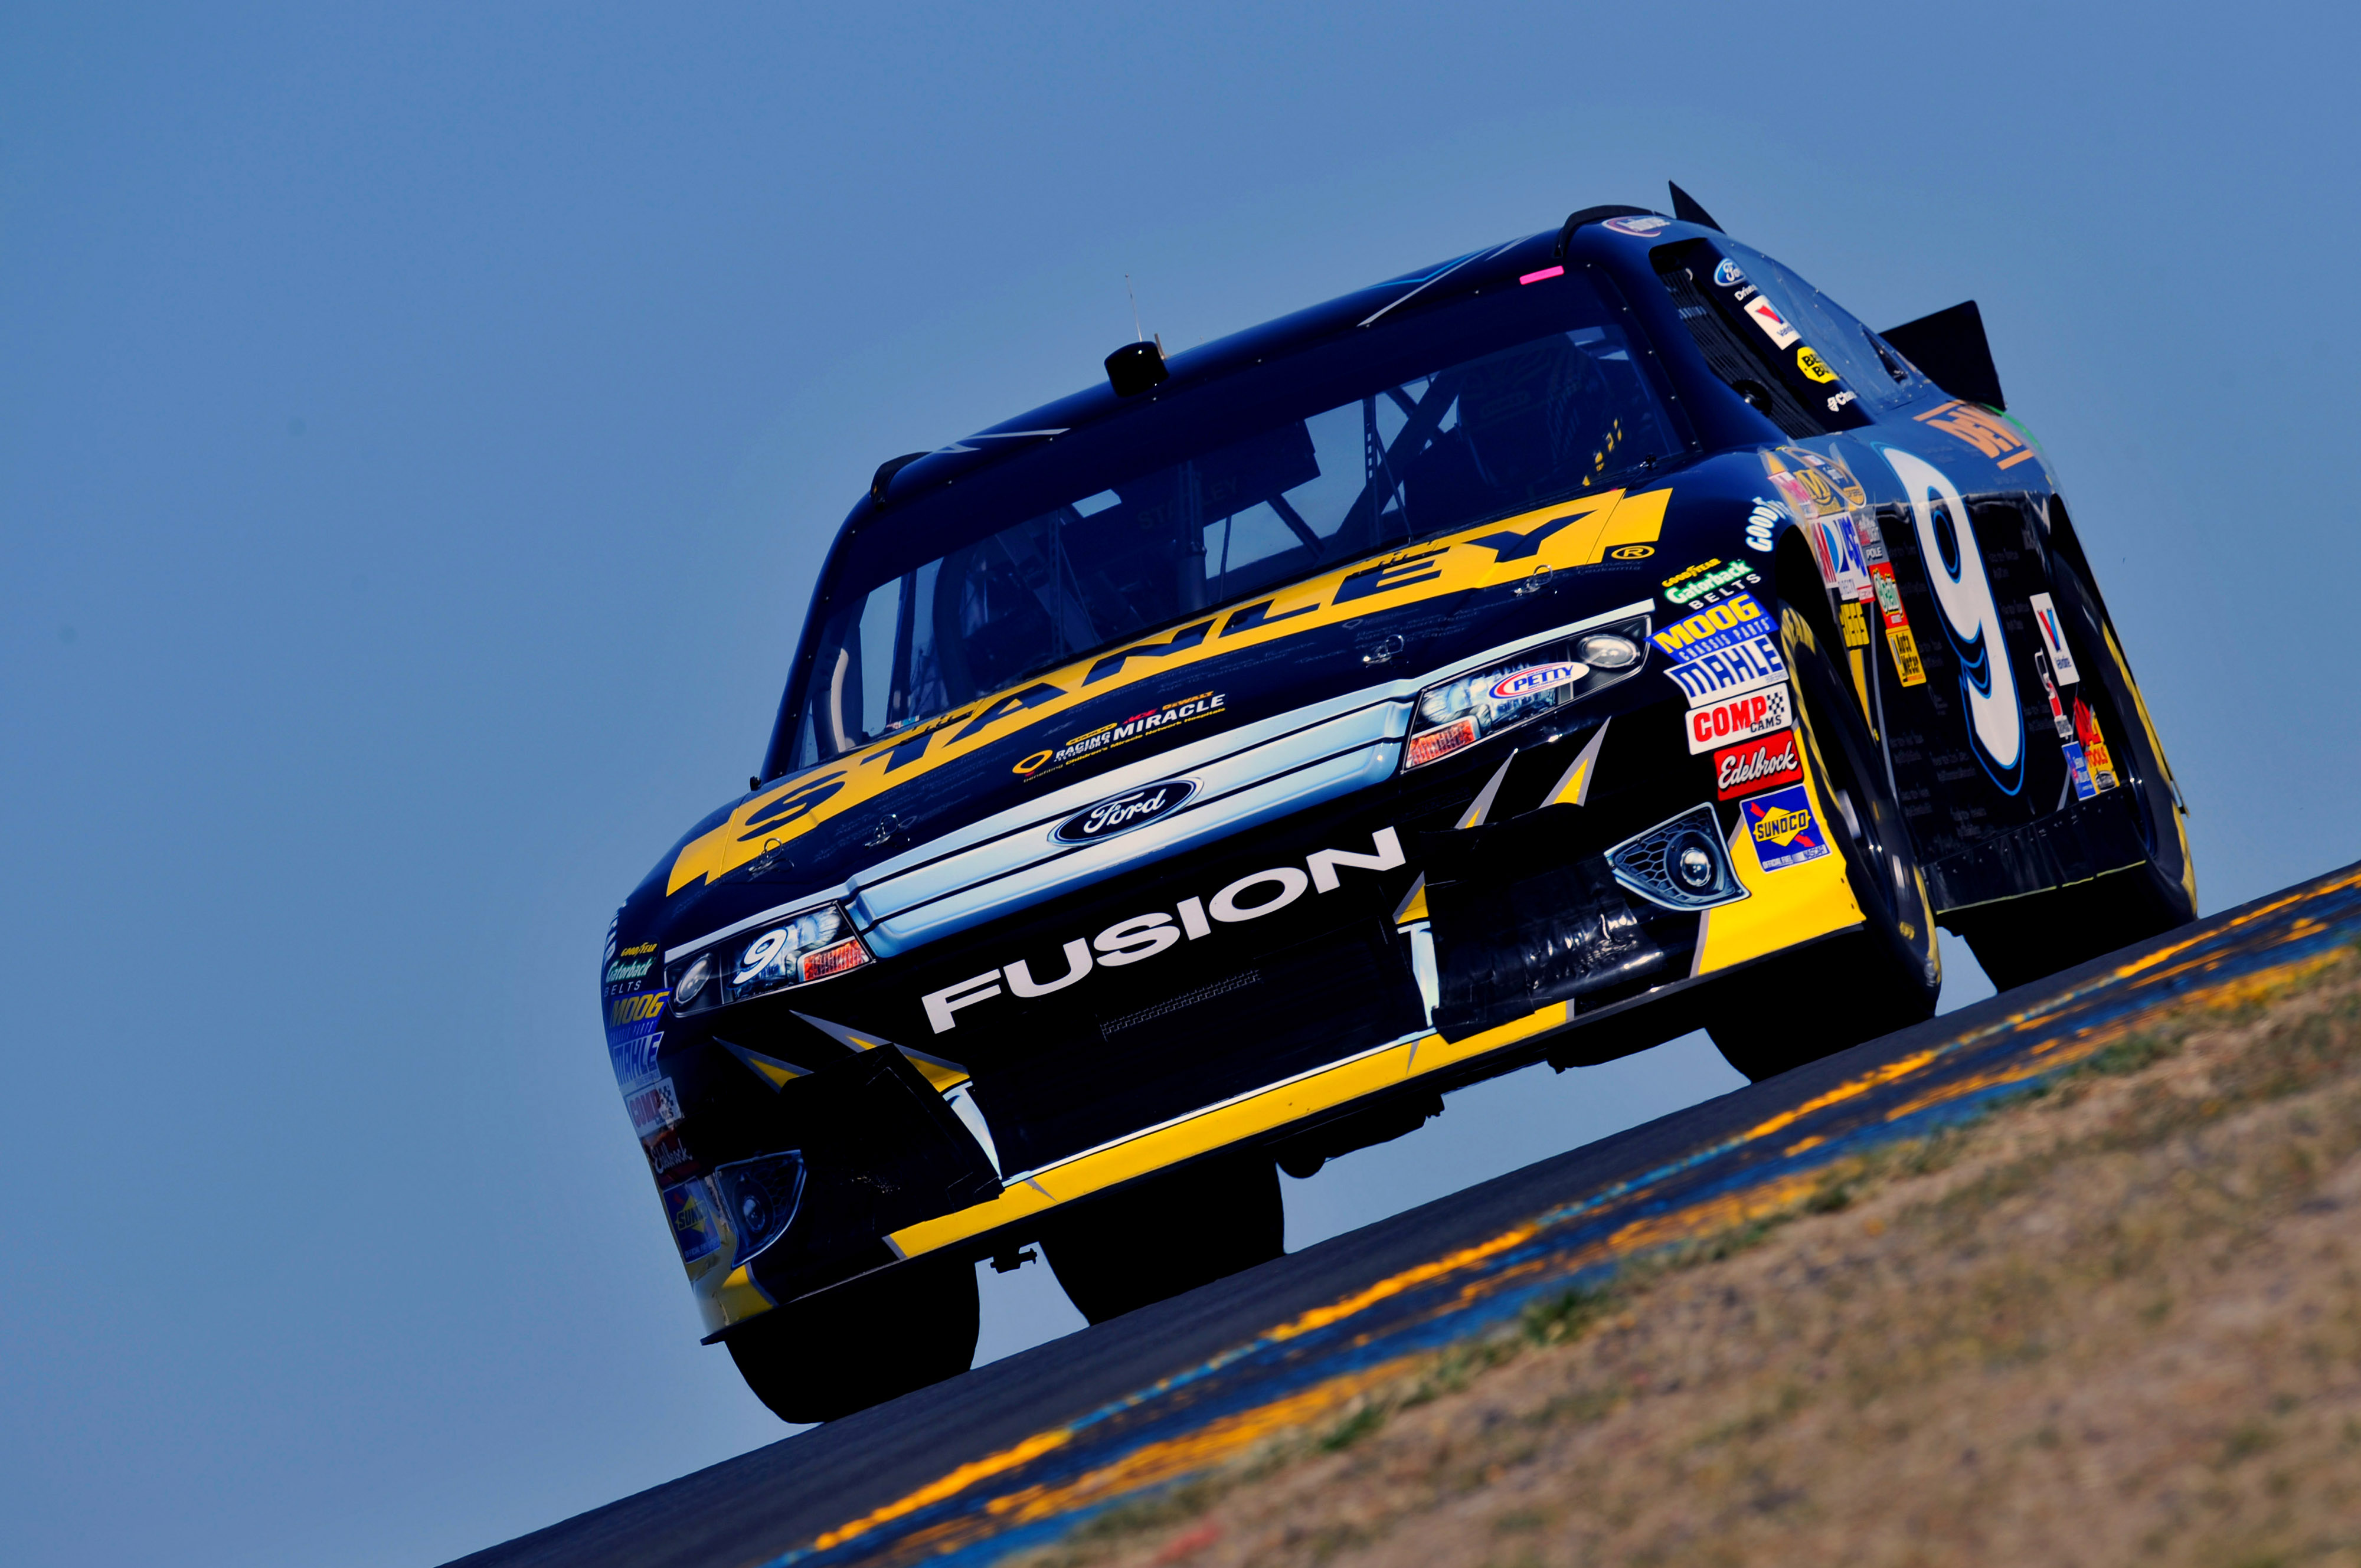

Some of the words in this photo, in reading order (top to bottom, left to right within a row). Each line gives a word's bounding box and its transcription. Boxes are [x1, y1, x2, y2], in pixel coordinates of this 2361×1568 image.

[1662, 558, 1722, 587] GOODYEAR
[1865, 546, 1883, 561] POLE
[1664, 561, 1754, 604] Gatorback
[1688, 573, 1761, 610] BELTS
[1653, 594, 1761, 654] MOOG
[1882, 446, 2023, 768] 9
[1679, 634, 1731, 661] CHASSIS
[1732, 618, 1770, 640] PARTS
[741, 510, 1598, 838] STANLEY
[1513, 664, 1574, 692] PETTY
[1669, 637, 1784, 698] MAHLE
[1055, 731, 1111, 760] RACING
[1113, 693, 1226, 741] MIRACLE
[1110, 734, 1143, 748] Miracle
[1145, 721, 1182, 736] Network
[1184, 708, 1226, 724] Hospitals
[1693, 695, 1767, 742] COMP
[1750, 714, 1782, 733] CAMS
[1718, 741, 1798, 790] Edelbrock
[1083, 788, 1166, 834] Ford
[1757, 812, 1806, 839] SUNOCO
[620, 942, 658, 957] GOODYEAR
[921, 826, 1407, 1035] FUSION
[606, 957, 655, 983] Gatorback
[732, 927, 789, 986] 9
[604, 980, 642, 997] BELTS
[609, 990, 671, 1029] MOOG
[629, 1088, 662, 1128] COMP
